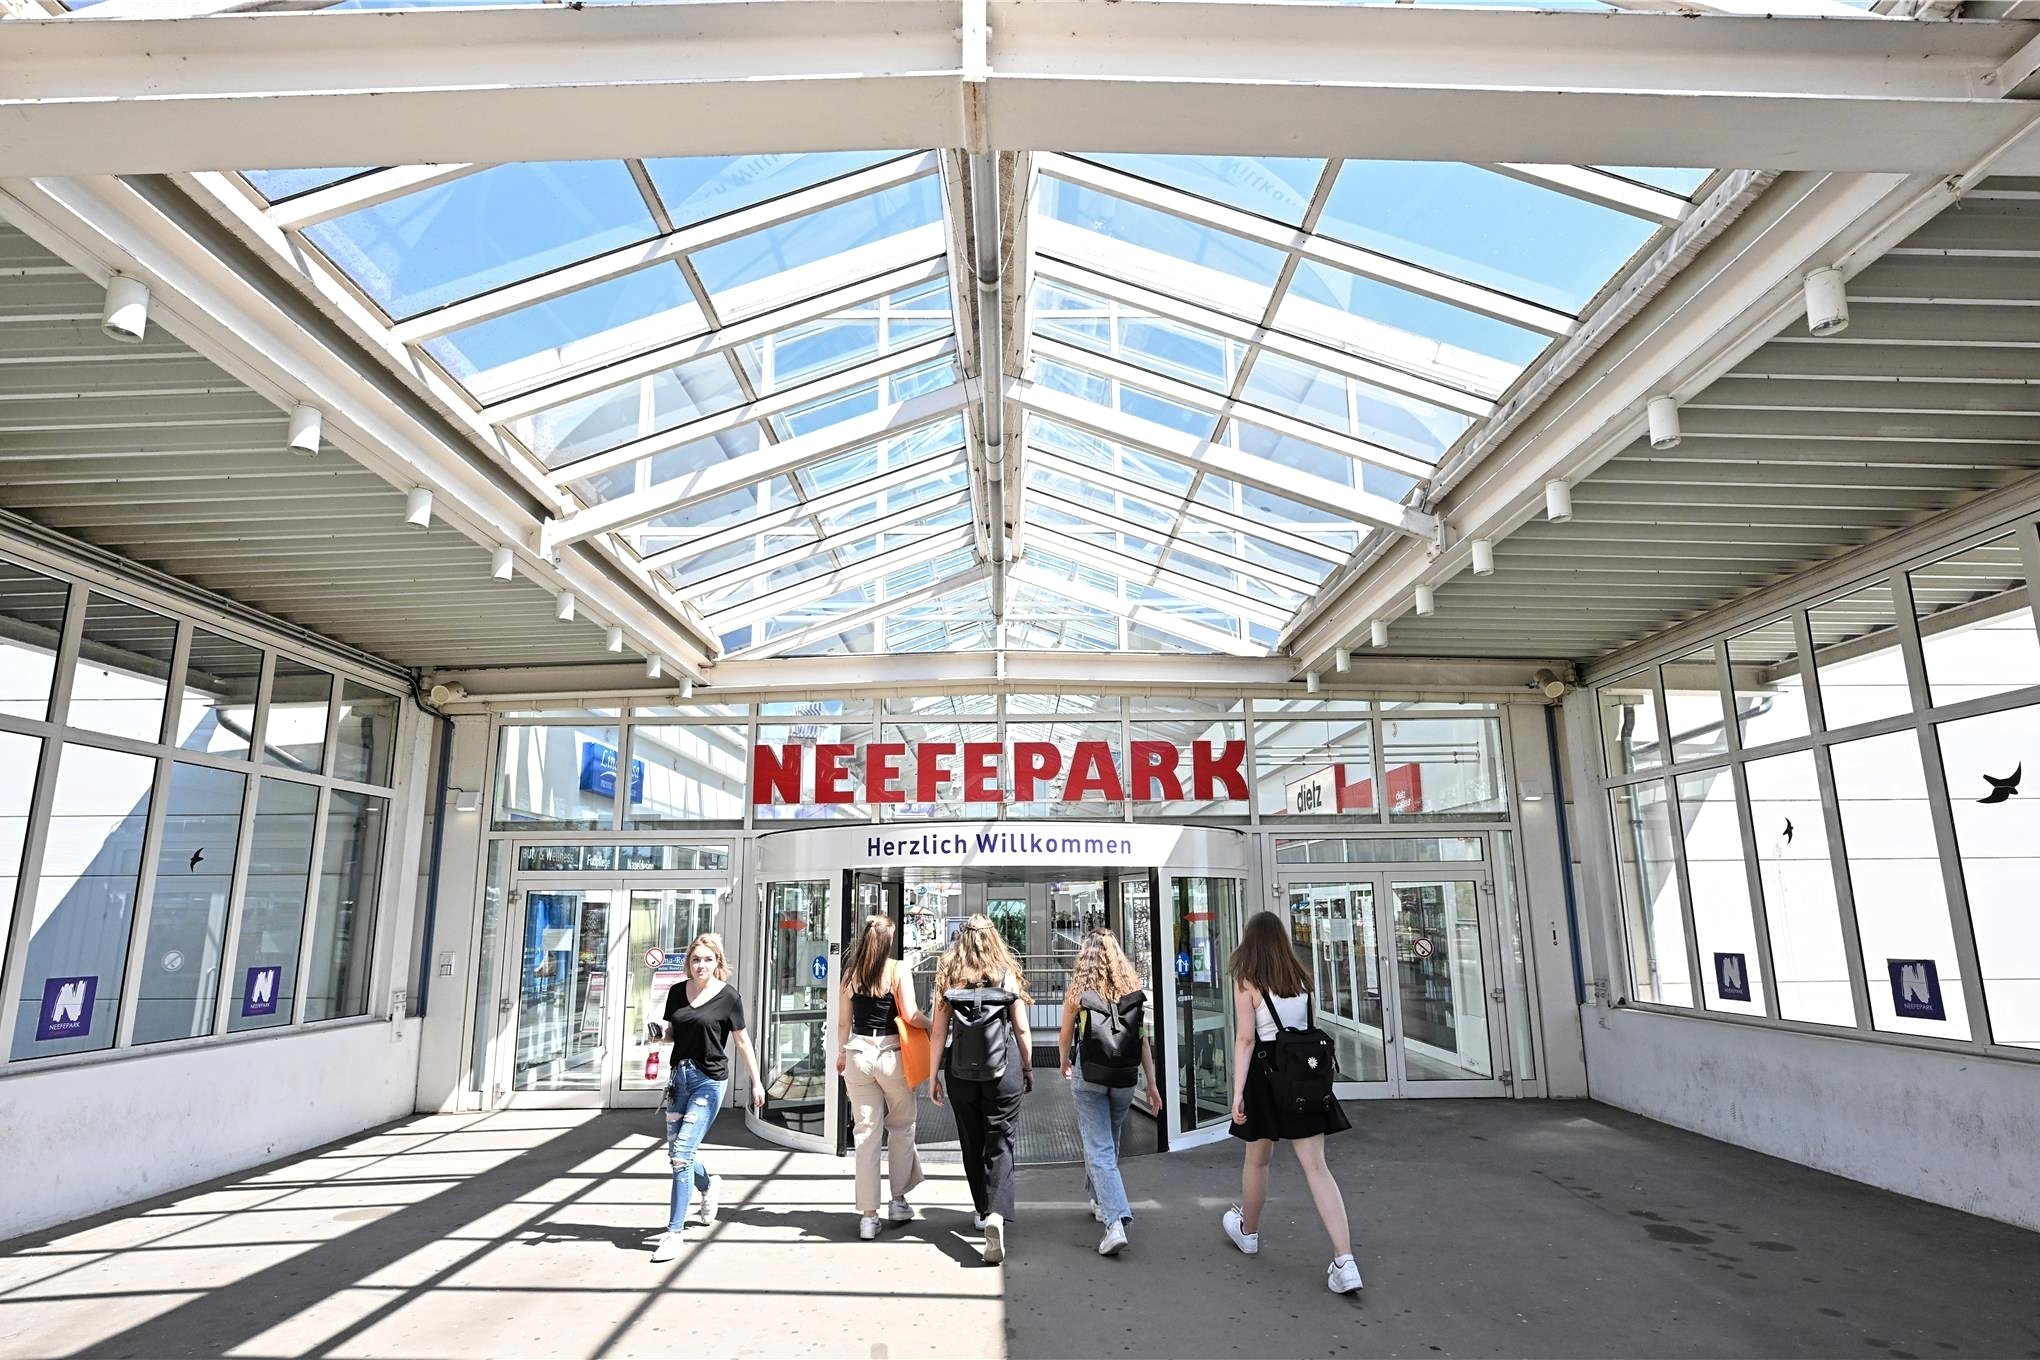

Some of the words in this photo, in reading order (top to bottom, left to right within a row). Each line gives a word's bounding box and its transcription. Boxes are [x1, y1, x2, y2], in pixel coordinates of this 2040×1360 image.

[752, 740, 1250, 804] NEEFEPARK
[1296, 780, 1322, 813] dietz
[546, 847, 575, 864] Wellness
[867, 834, 967, 857] Herzlich
[976, 832, 1132, 855] Willkommen
[252, 969, 275, 1003] N
[1722, 956, 1742, 989] N
[1900, 963, 1930, 1004] N
[51, 980, 88, 1022] N
[49, 1022, 81, 1030] NEEFEPARK
